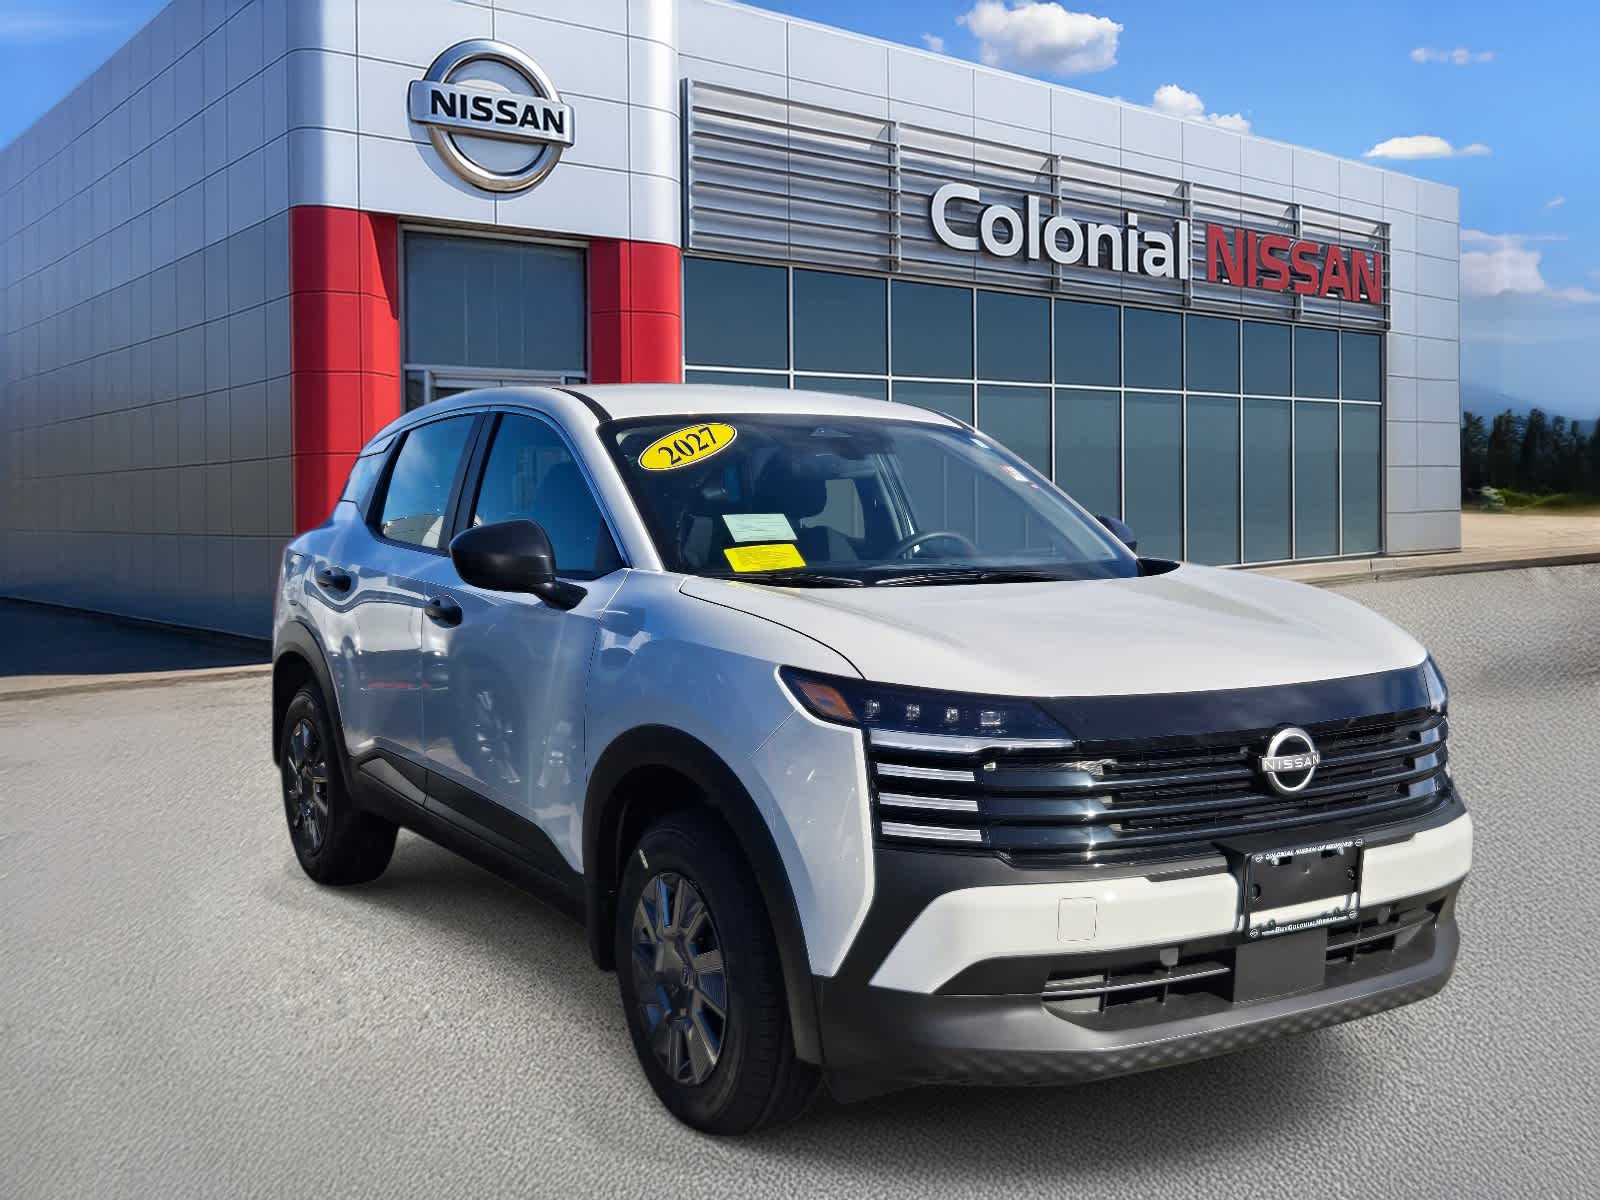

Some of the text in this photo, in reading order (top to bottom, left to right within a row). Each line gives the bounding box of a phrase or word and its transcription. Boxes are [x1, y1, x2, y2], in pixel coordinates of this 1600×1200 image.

[430, 89, 565, 135] NISSAN
[930, 182, 1382, 304] Colonial NISSAN
[658, 426, 717, 465] 2027
[1264, 752, 1319, 770] NISSAN
